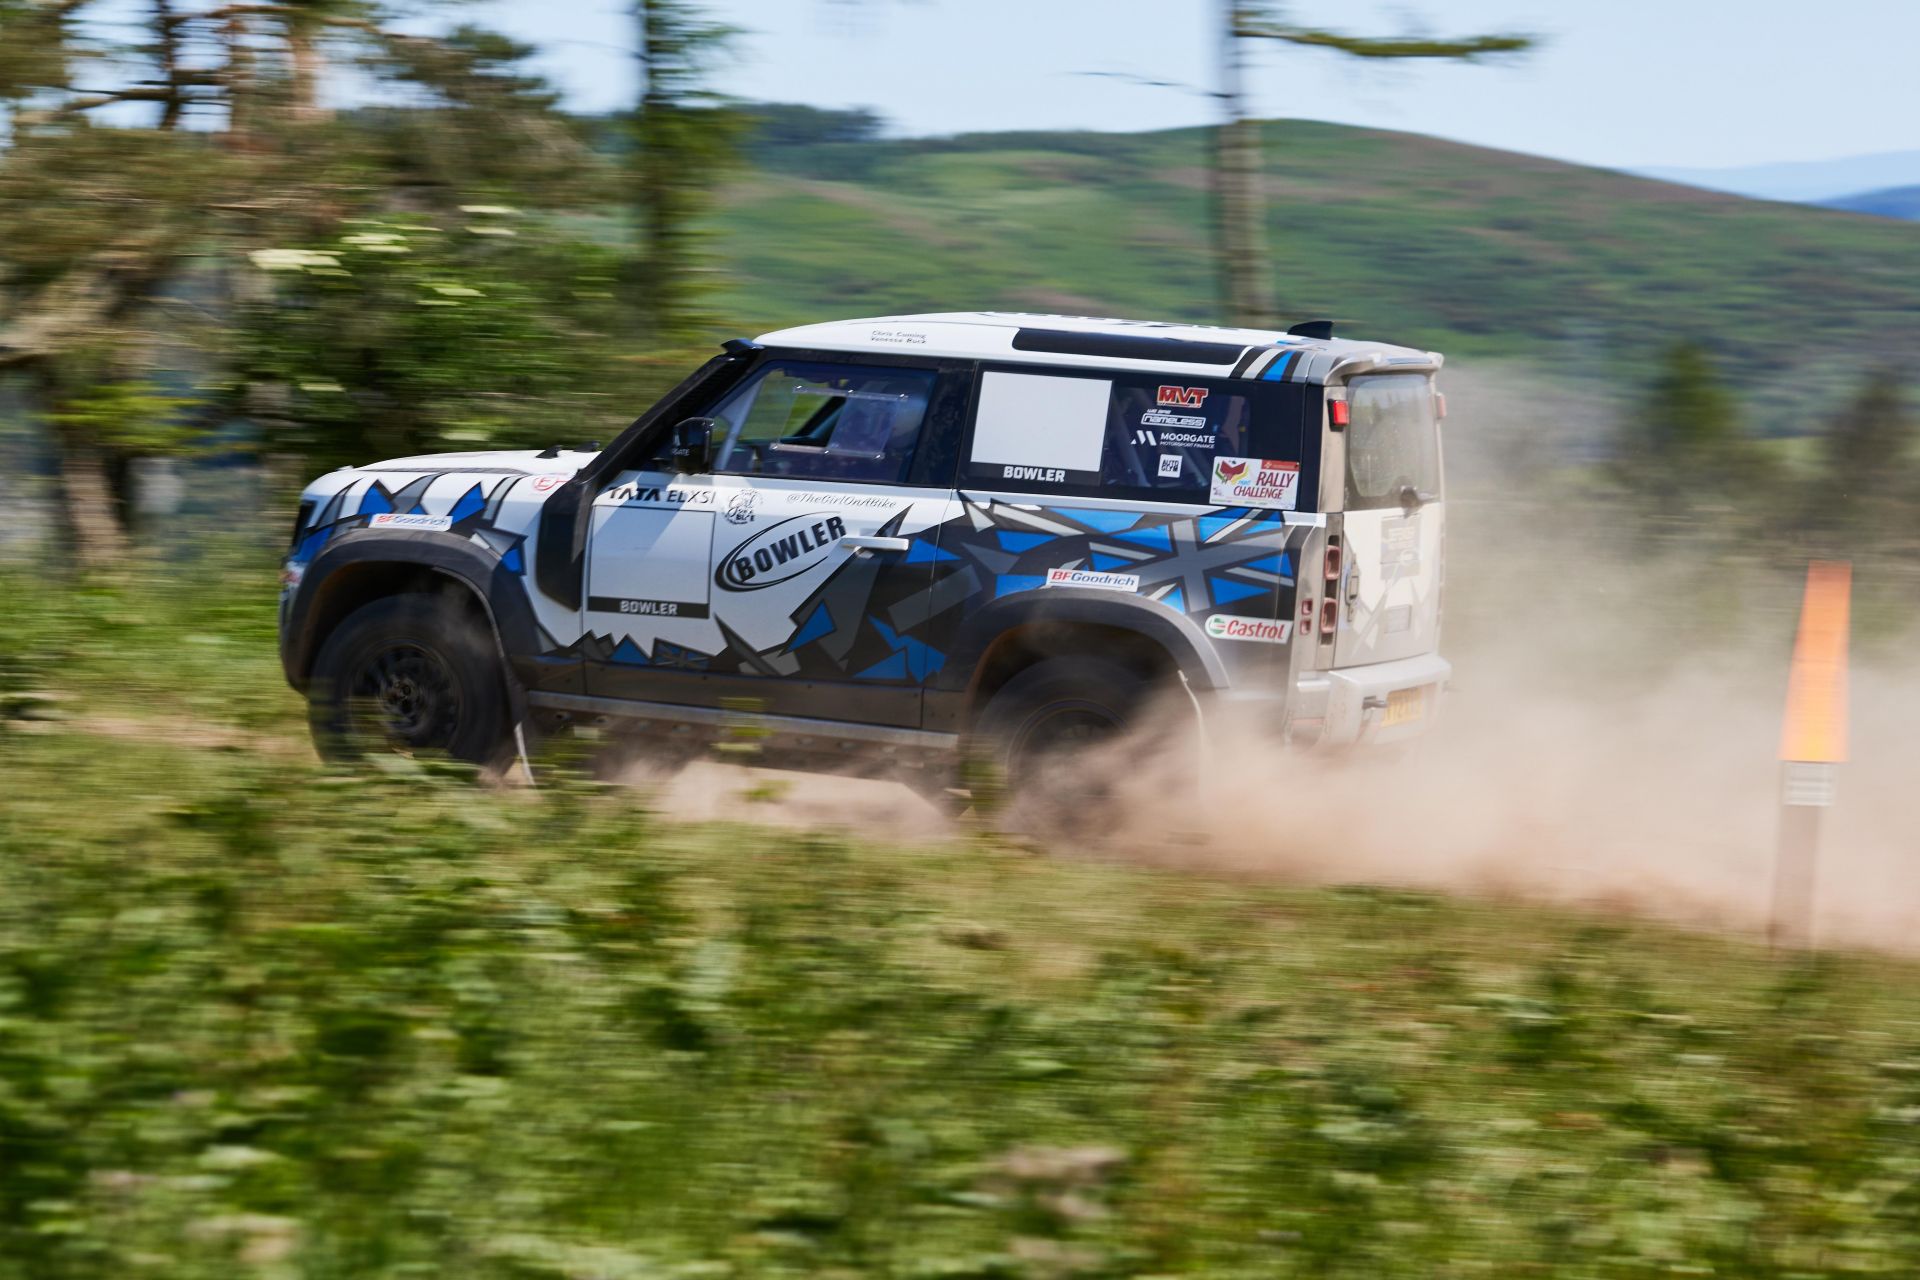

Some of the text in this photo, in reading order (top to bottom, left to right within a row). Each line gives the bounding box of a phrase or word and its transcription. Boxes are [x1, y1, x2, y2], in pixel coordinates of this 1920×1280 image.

[1158, 386, 1208, 405] MVT
[1160, 432, 1216, 444] MOORGATE
[1162, 459, 1179, 467] AUTO
[1003, 465, 1066, 483] BOWLER
[1256, 471, 1295, 488] RALLY
[608, 486, 717, 504] TATA ELXSI
[786, 493, 897, 508] @TheGirlOnABike
[1233, 485, 1284, 500] CHALLENGE
[735, 515, 847, 583] BOWLER
[1051, 571, 1135, 587] BFGoodrich
[620, 600, 678, 616] BOWLER
[1227, 620, 1286, 640] Castrol
